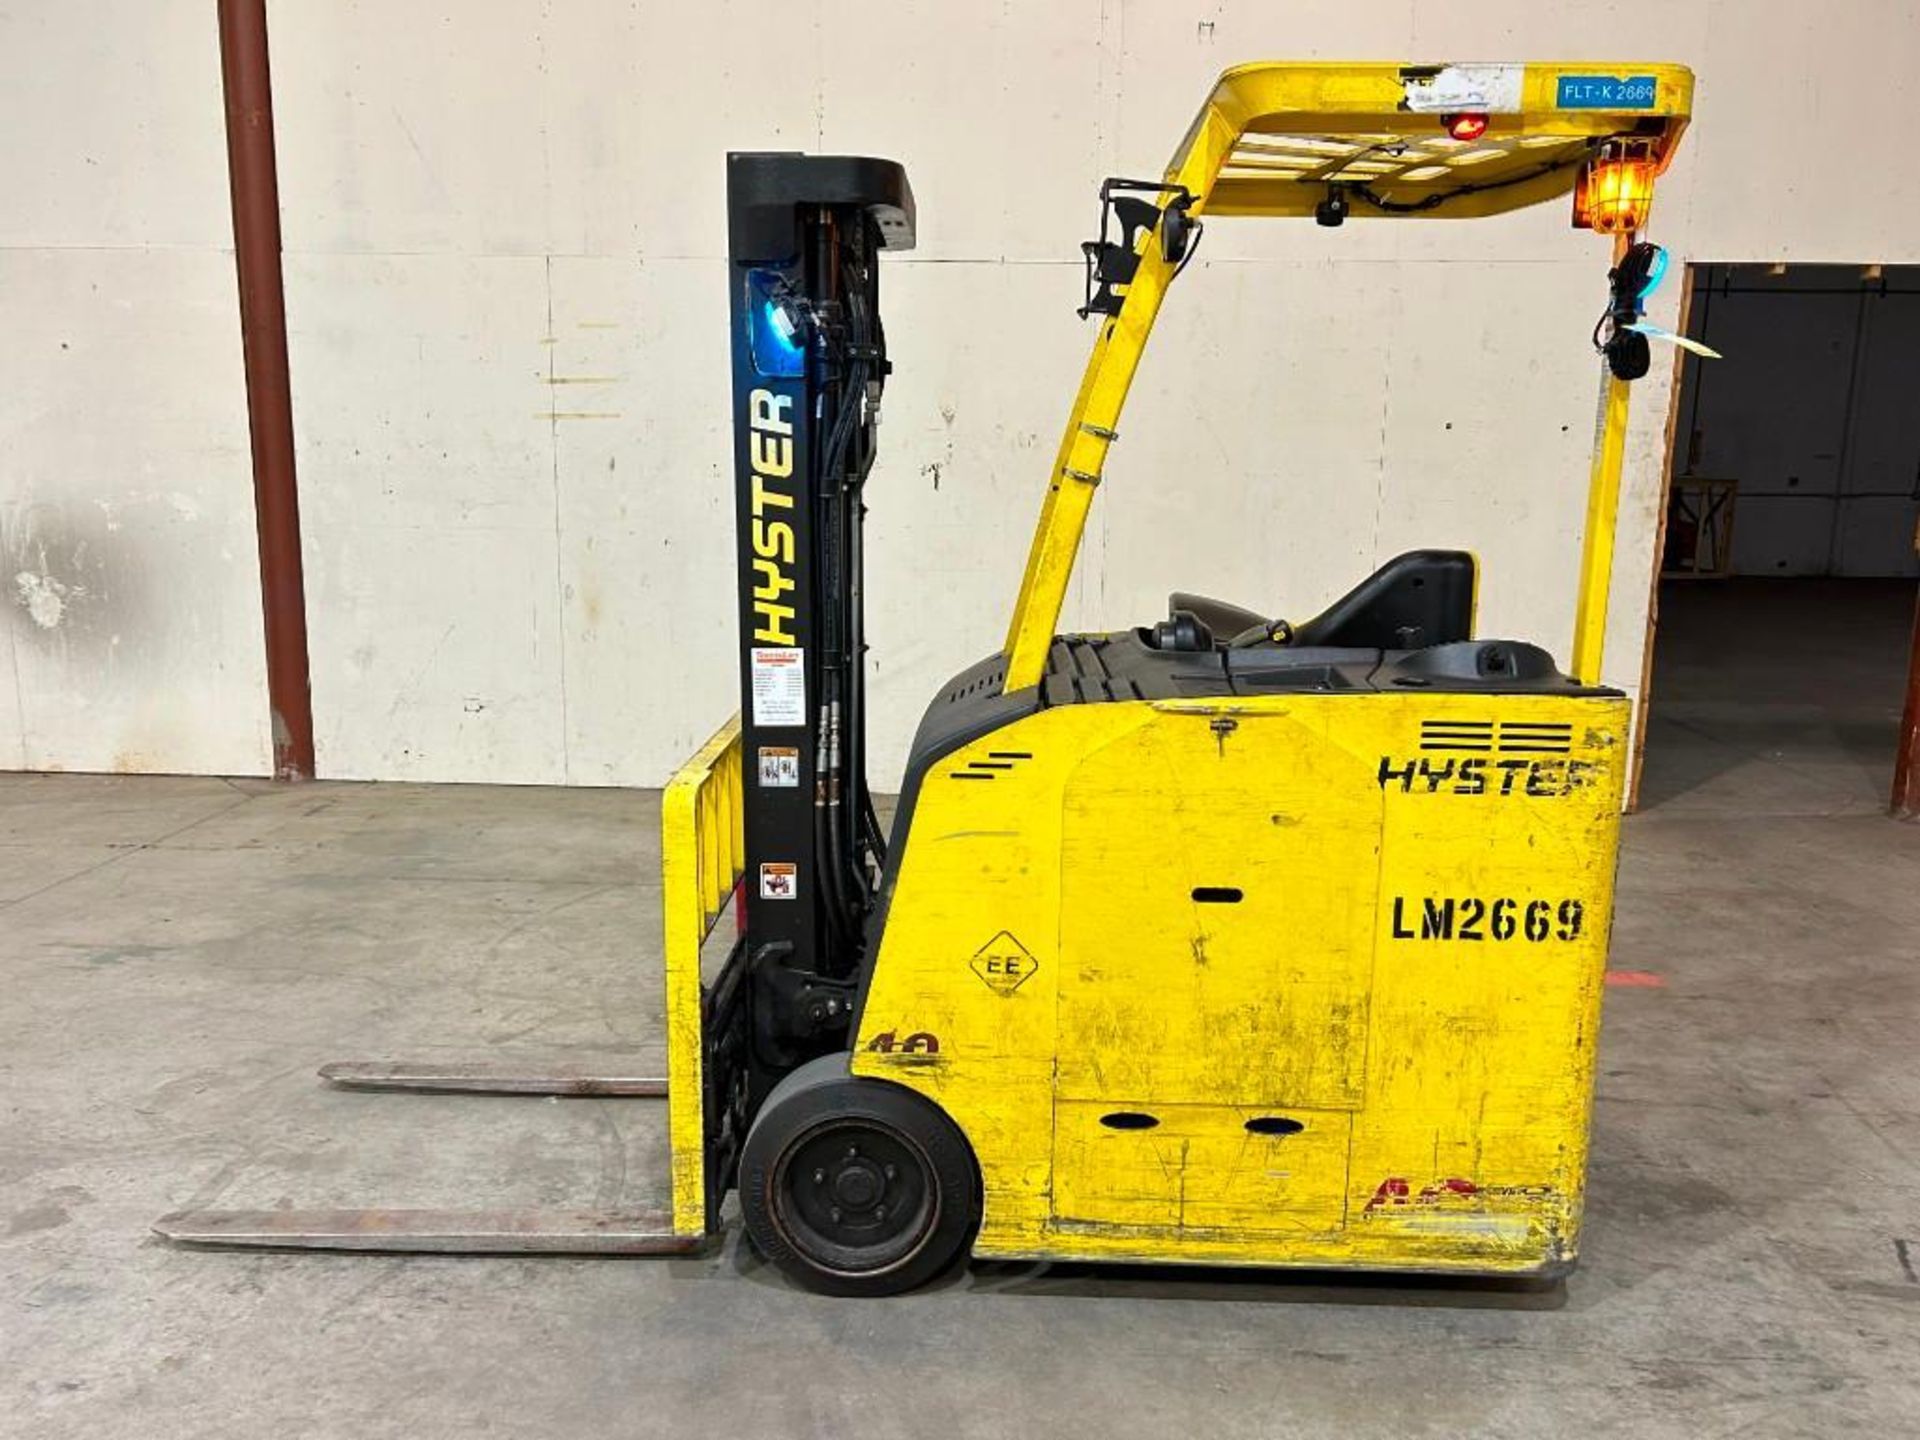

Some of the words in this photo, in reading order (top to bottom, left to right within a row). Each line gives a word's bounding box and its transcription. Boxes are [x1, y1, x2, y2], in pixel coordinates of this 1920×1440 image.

[750, 388, 795, 646] HYSTER
[1392, 897, 1584, 942] LM2669
[986, 955, 1021, 975] EE
